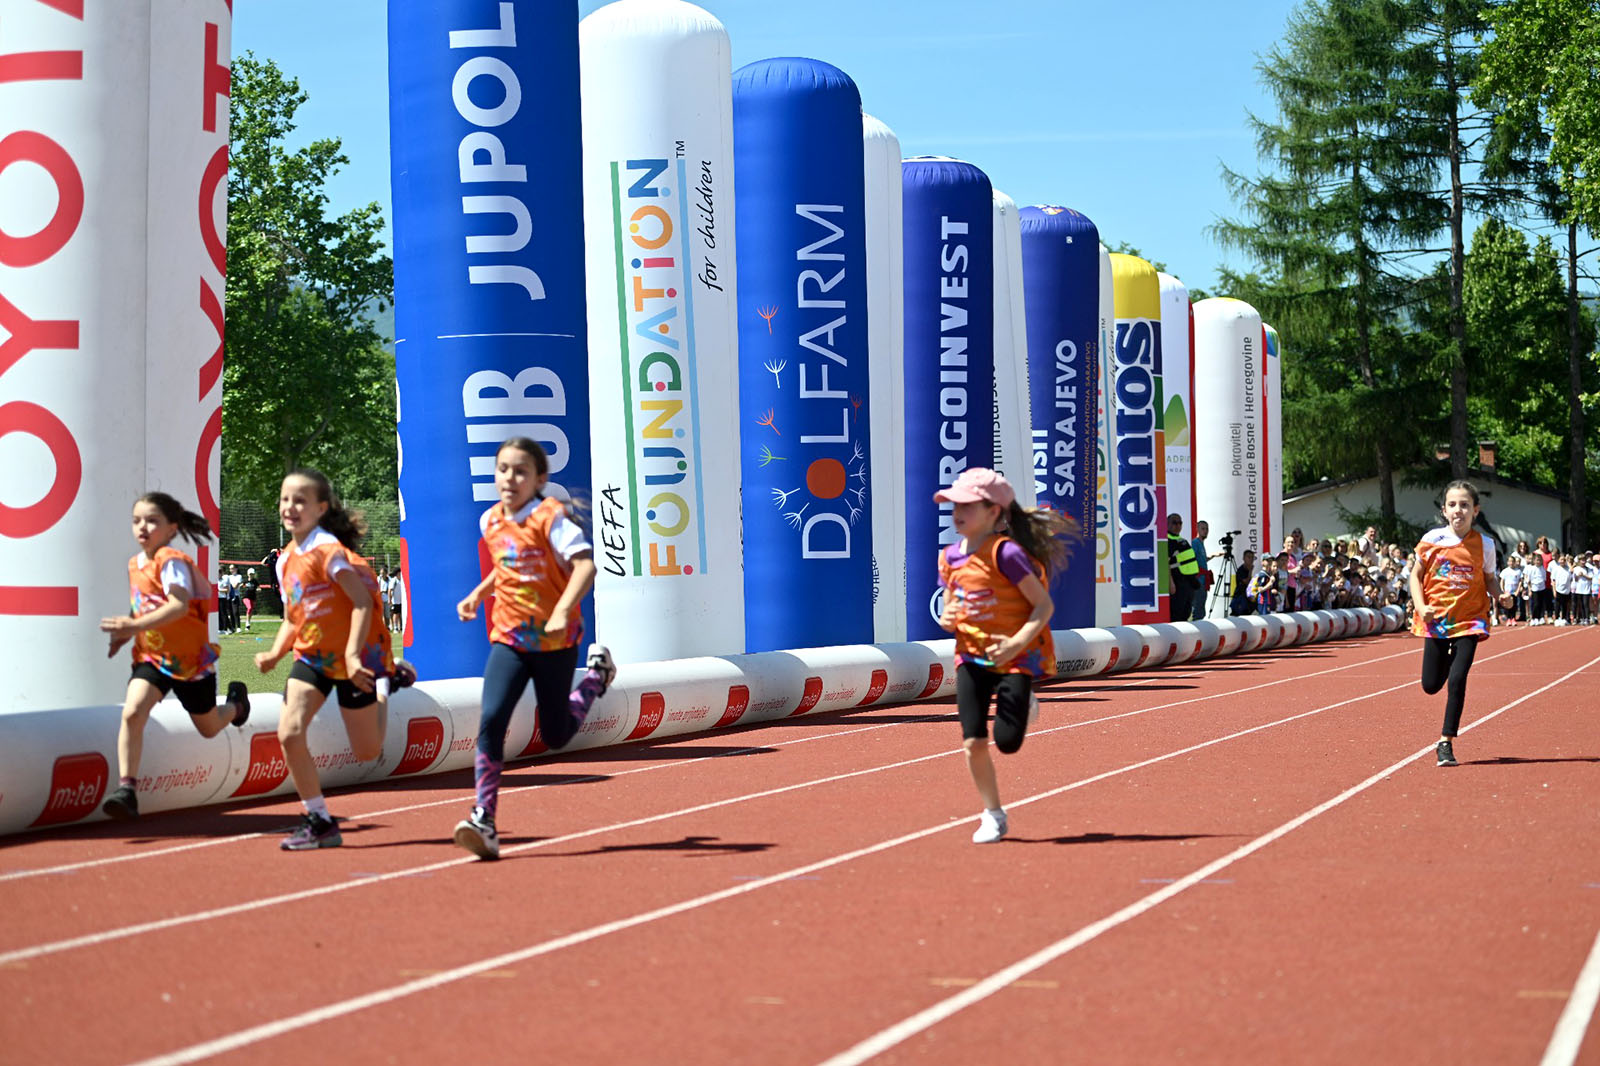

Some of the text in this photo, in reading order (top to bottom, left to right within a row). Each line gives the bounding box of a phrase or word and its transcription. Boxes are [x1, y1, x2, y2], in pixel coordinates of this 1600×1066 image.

[449, 2, 546, 301] JUPOL
[695, 160, 723, 292] for children
[626, 159, 694, 576] FOUNDATION
[938, 216, 969, 554] NRGOINVEST
[1084, 341, 1092, 387] SARAJEVO
[1242, 336, 1255, 412] Hercegovine
[1054, 339, 1077, 497] SARAJEVO
[1229, 422, 1242, 477] Pokrovitelj
[1244, 422, 1256, 459] Bosne
[1115, 322, 1156, 609] mentos
[1245, 462, 1257, 525] Federacije
[601, 483, 625, 577] UEFA
[1247, 528, 1258, 556] ada
[150, 765, 213, 794] prijatelje!
